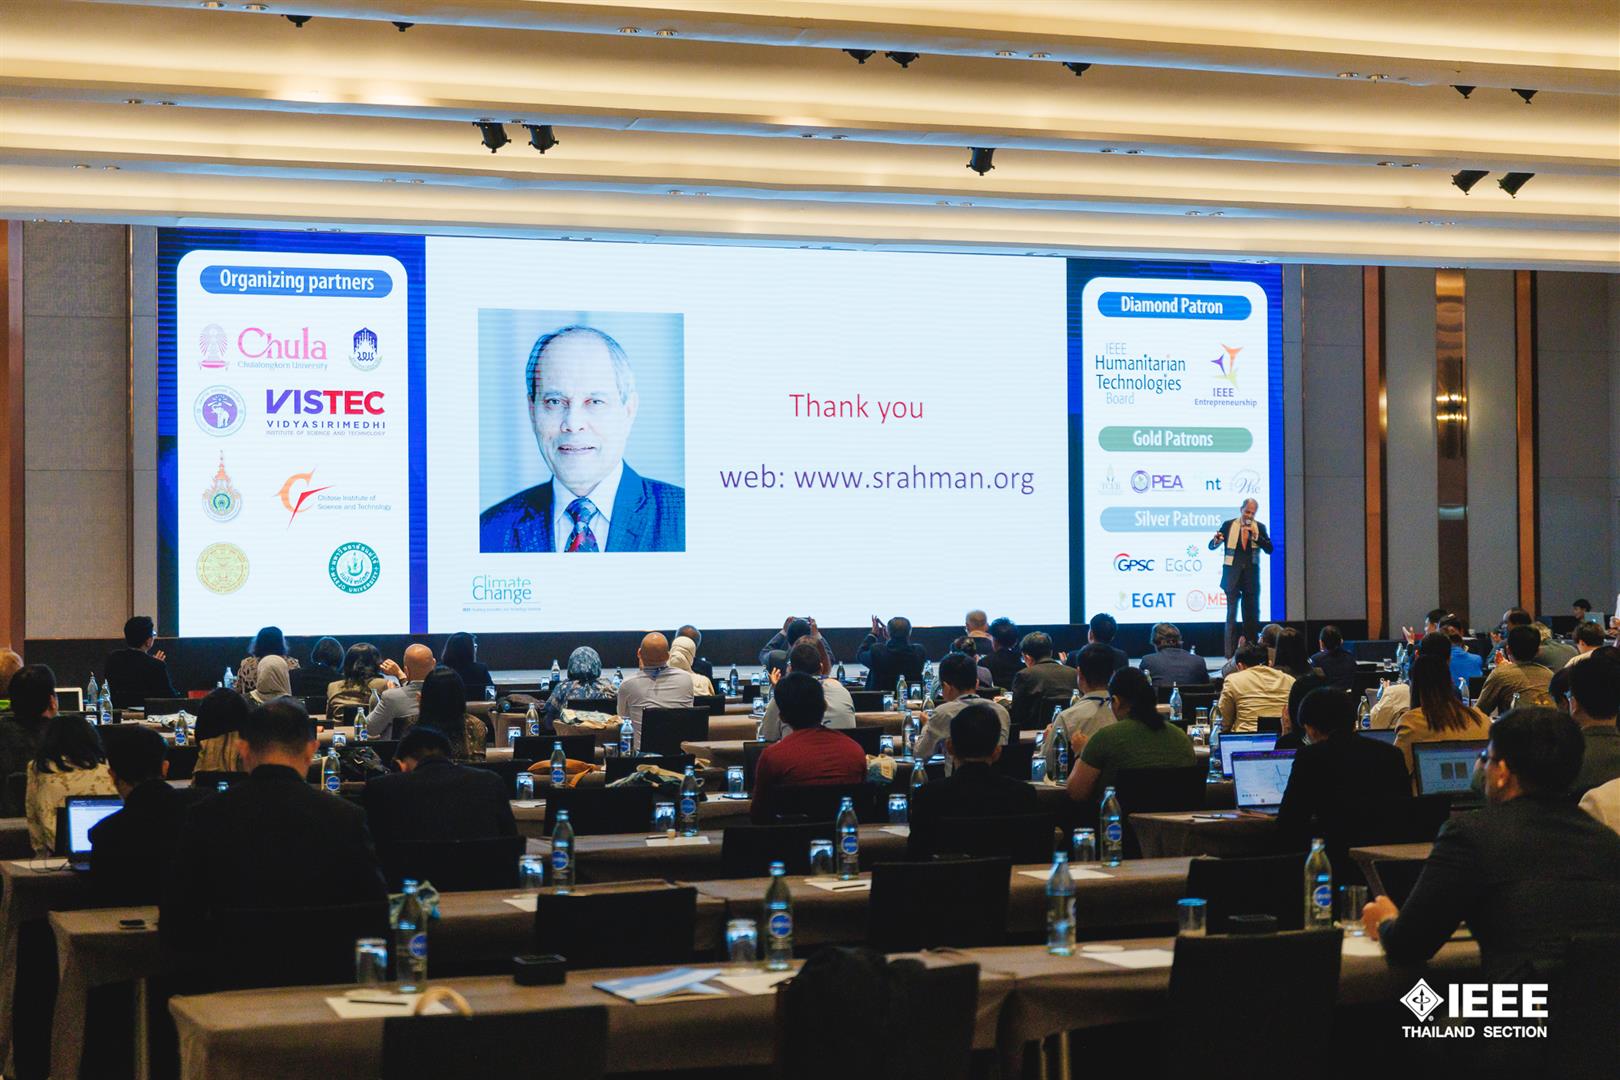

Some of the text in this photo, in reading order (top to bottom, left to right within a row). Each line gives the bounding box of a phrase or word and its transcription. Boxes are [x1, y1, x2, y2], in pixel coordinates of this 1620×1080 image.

[220, 269, 375, 293] Organizing partners
[1121, 296, 1223, 314] Diamond Patron
[238, 327, 328, 360] Chula
[1105, 342, 1127, 354] IEEE
[292, 362, 328, 371] University
[1095, 354, 1186, 371] Humanitarian
[1096, 373, 1182, 394] Technologies
[1106, 391, 1135, 404] Board
[1213, 387, 1234, 397] IEEE
[266, 389, 385, 415] VISTEC
[789, 393, 924, 424] Thank you
[1194, 398, 1258, 408] Entrepreneurship
[266, 420, 386, 429] VIDYASIRIMEDHI
[1133, 430, 1214, 447] Gold Patrons
[719, 463, 1035, 495] web: www.srahman.org
[1152, 475, 1184, 488] PEA
[1206, 478, 1221, 490] nt
[1135, 510, 1222, 527] Silver Patrons
[1118, 559, 1155, 572] GPSC
[1165, 558, 1202, 572] EGCO
[472, 574, 532, 588] Climate
[472, 585, 532, 605] Change
[1131, 592, 1176, 608] EGAT
[1207, 592, 1228, 605] ME
